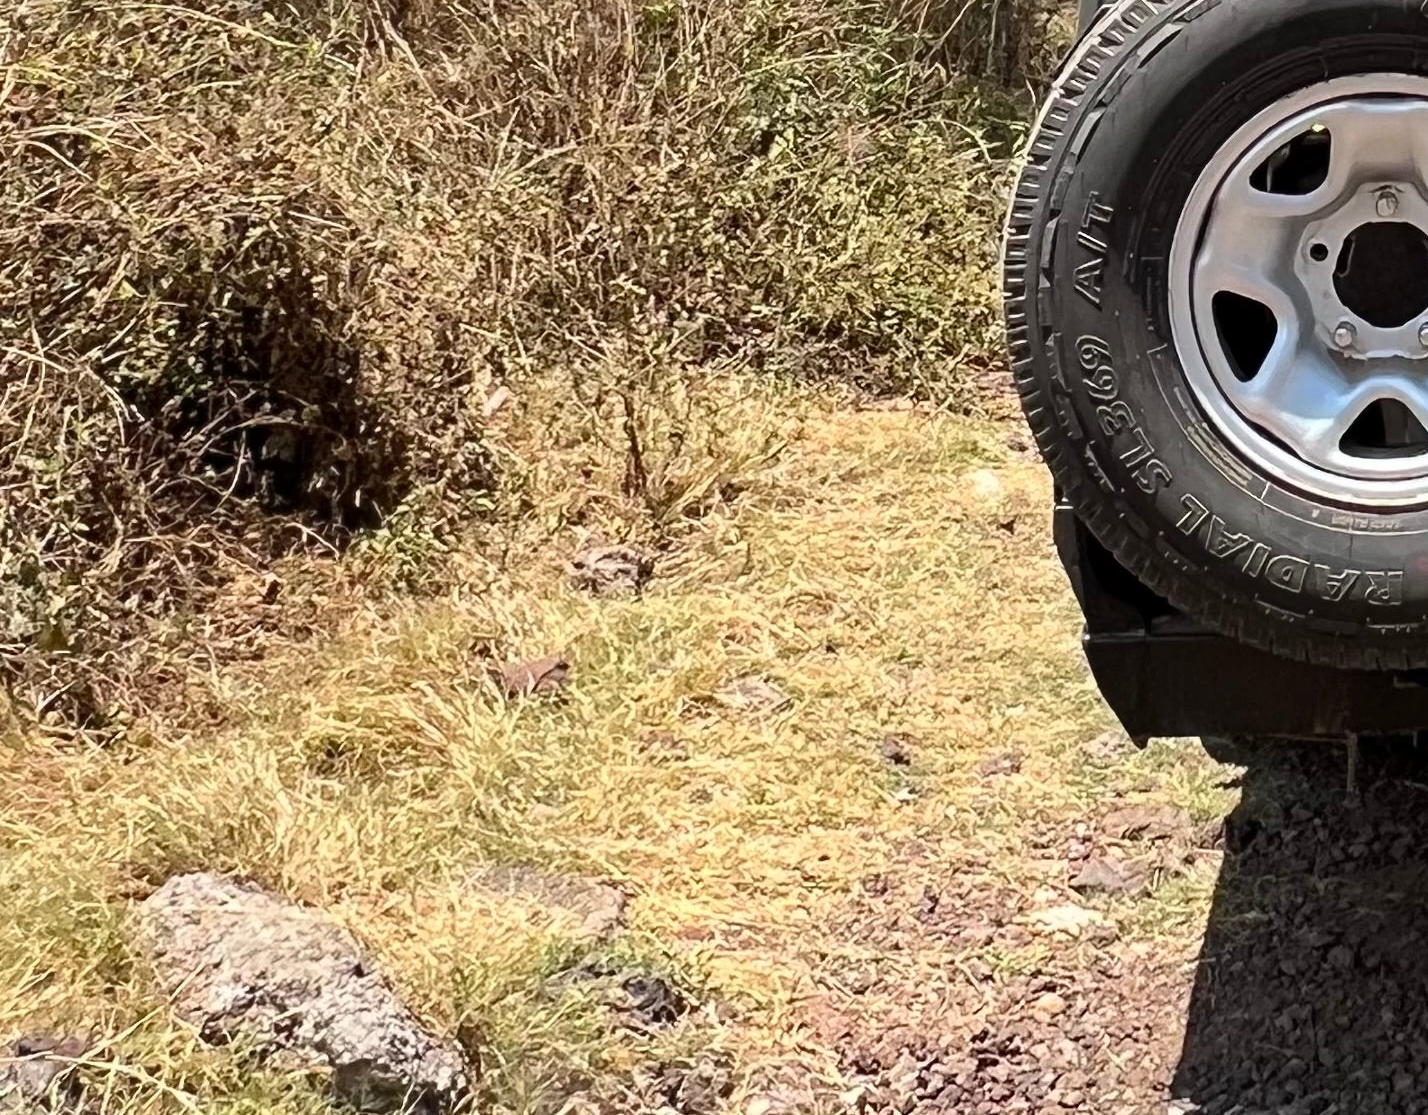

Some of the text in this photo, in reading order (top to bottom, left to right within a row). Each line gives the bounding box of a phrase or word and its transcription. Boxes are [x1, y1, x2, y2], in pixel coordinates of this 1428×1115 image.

[1072, 190, 1115, 307] A/T
[1075, 334, 1174, 494] SL369
[1175, 492, 1404, 606] RADIAL
